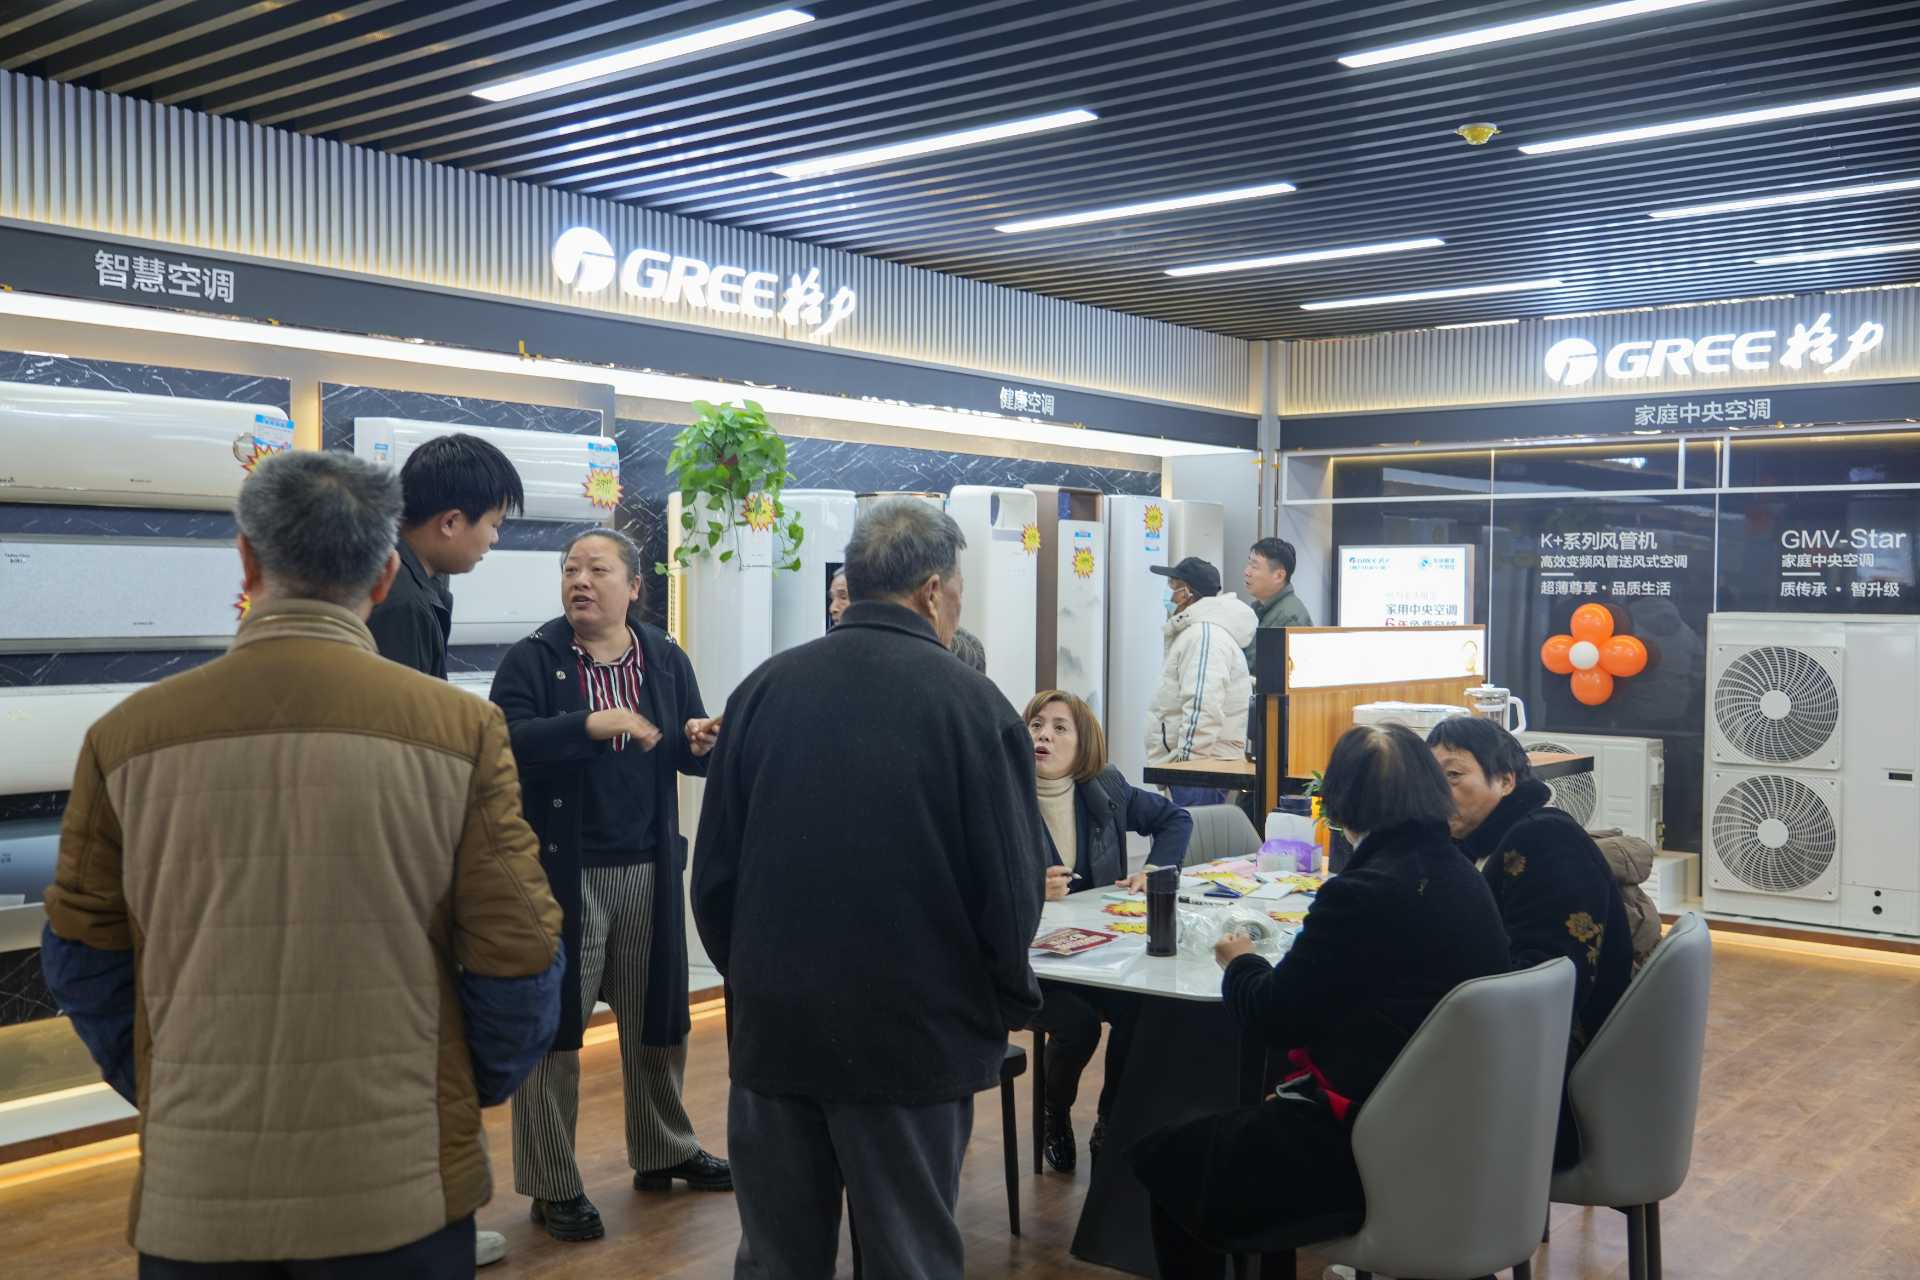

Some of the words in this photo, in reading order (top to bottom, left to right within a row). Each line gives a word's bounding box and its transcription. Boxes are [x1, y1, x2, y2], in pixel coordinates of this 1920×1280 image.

[94, 249, 235, 304] 智慧空调
[619, 248, 778, 318] GREE
[776, 267, 857, 337] 格力
[1605, 330, 1776, 379] GREE
[1779, 312, 1885, 375] 格力
[999, 386, 1055, 417] 健康空调
[1634, 398, 1772, 426] 家庭中央空调
[1540, 531, 1658, 550] K+系列风管机
[1781, 528, 1907, 549] GMV-Star
[1540, 555, 1688, 568] 高效变频风管送风式空调
[1781, 553, 1875, 568] 家庭中央空调
[1385, 603, 1458, 616] 家用中央空调
